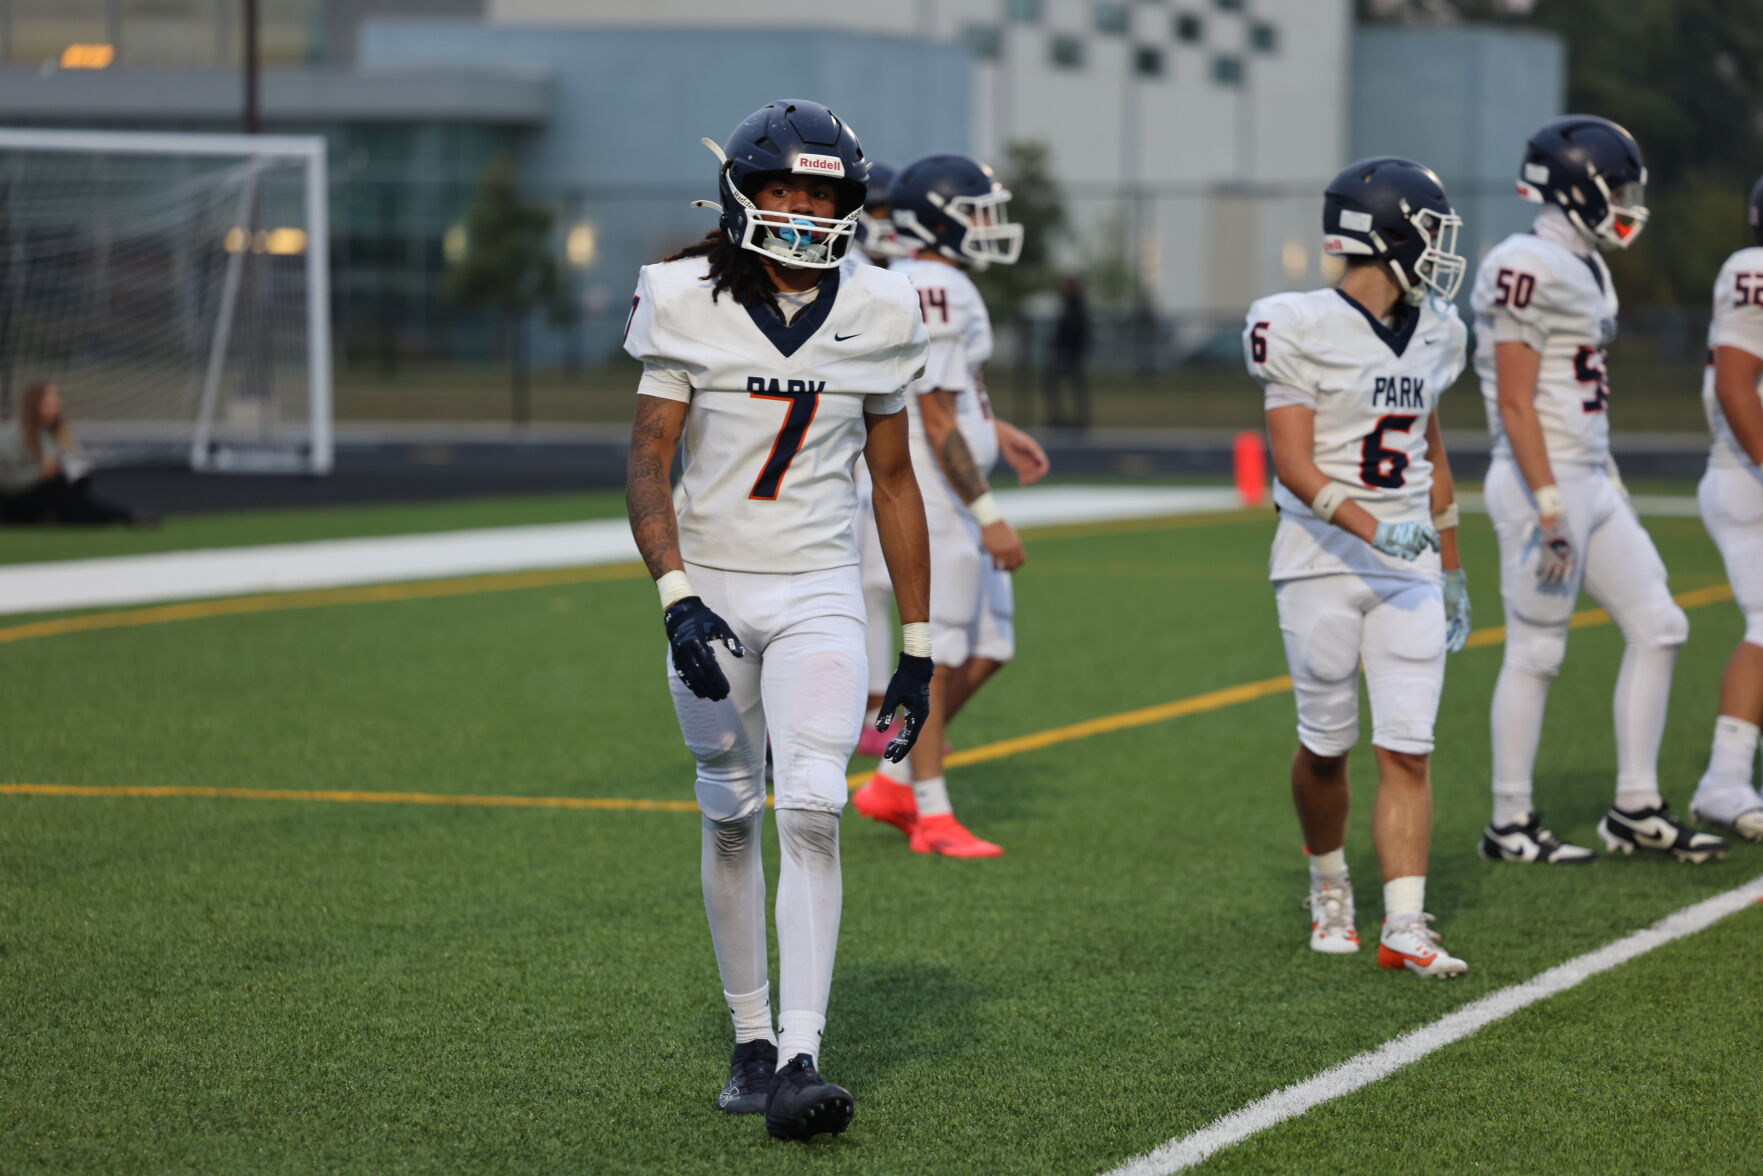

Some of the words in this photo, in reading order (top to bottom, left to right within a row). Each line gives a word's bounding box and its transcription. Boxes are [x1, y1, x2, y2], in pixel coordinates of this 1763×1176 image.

[799, 157, 841, 171] Riddell
[1494, 268, 1536, 310] 50
[1250, 320, 1270, 365] 6
[1371, 376, 1424, 408] PARK
[747, 391, 819, 501] 7
[1359, 413, 1419, 490] 6
